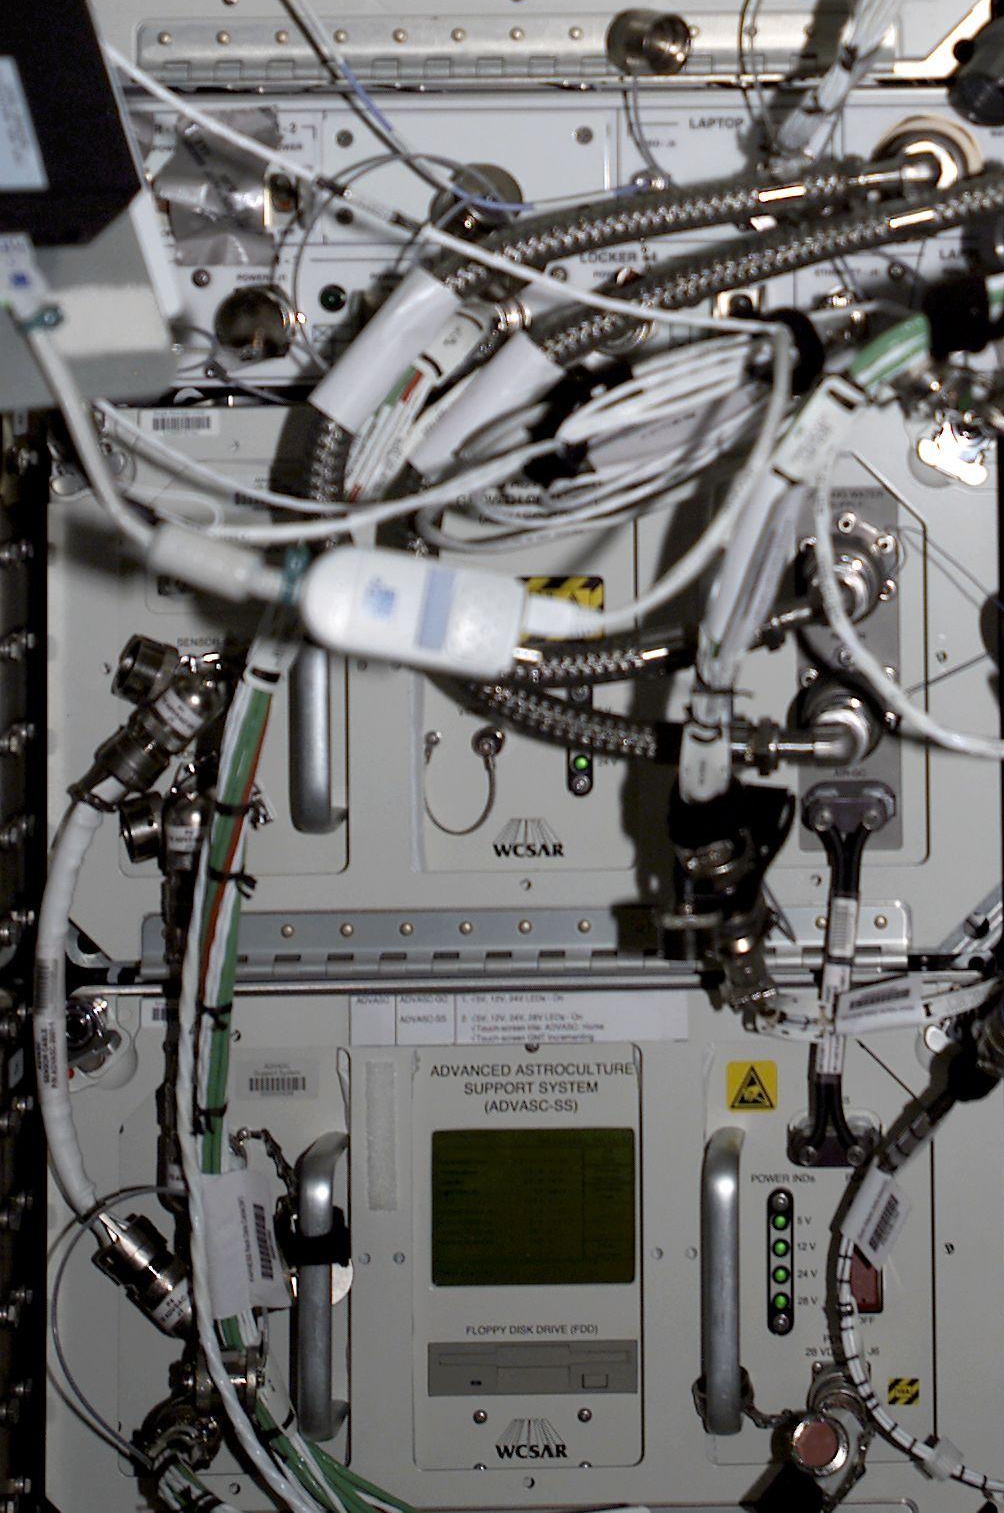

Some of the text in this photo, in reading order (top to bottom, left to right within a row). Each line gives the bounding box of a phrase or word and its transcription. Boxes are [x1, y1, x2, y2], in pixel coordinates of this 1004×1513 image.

[688, 117, 744, 130] LAPTOP
[579, 251, 638, 264] LOCKER
[493, 843, 564, 858] WCSAR
[429, 1061, 634, 1078] ADVANCED ASTROCULTURE
[463, 1081, 599, 1096] SUPPORT SYSTEM
[483, 1098, 579, 1115] (ADVASC-SS)
[750, 1173, 790, 1185] POWER
[804, 1216, 813, 1226] V
[797, 1242, 817, 1251] 12 V
[797, 1269, 819, 1279] 24 V
[797, 1296, 819, 1306] 28 V
[465, 1323, 599, 1336] FLOPPY DISK DRIVE (FDD)
[495, 1443, 568, 1458] WCSAR
